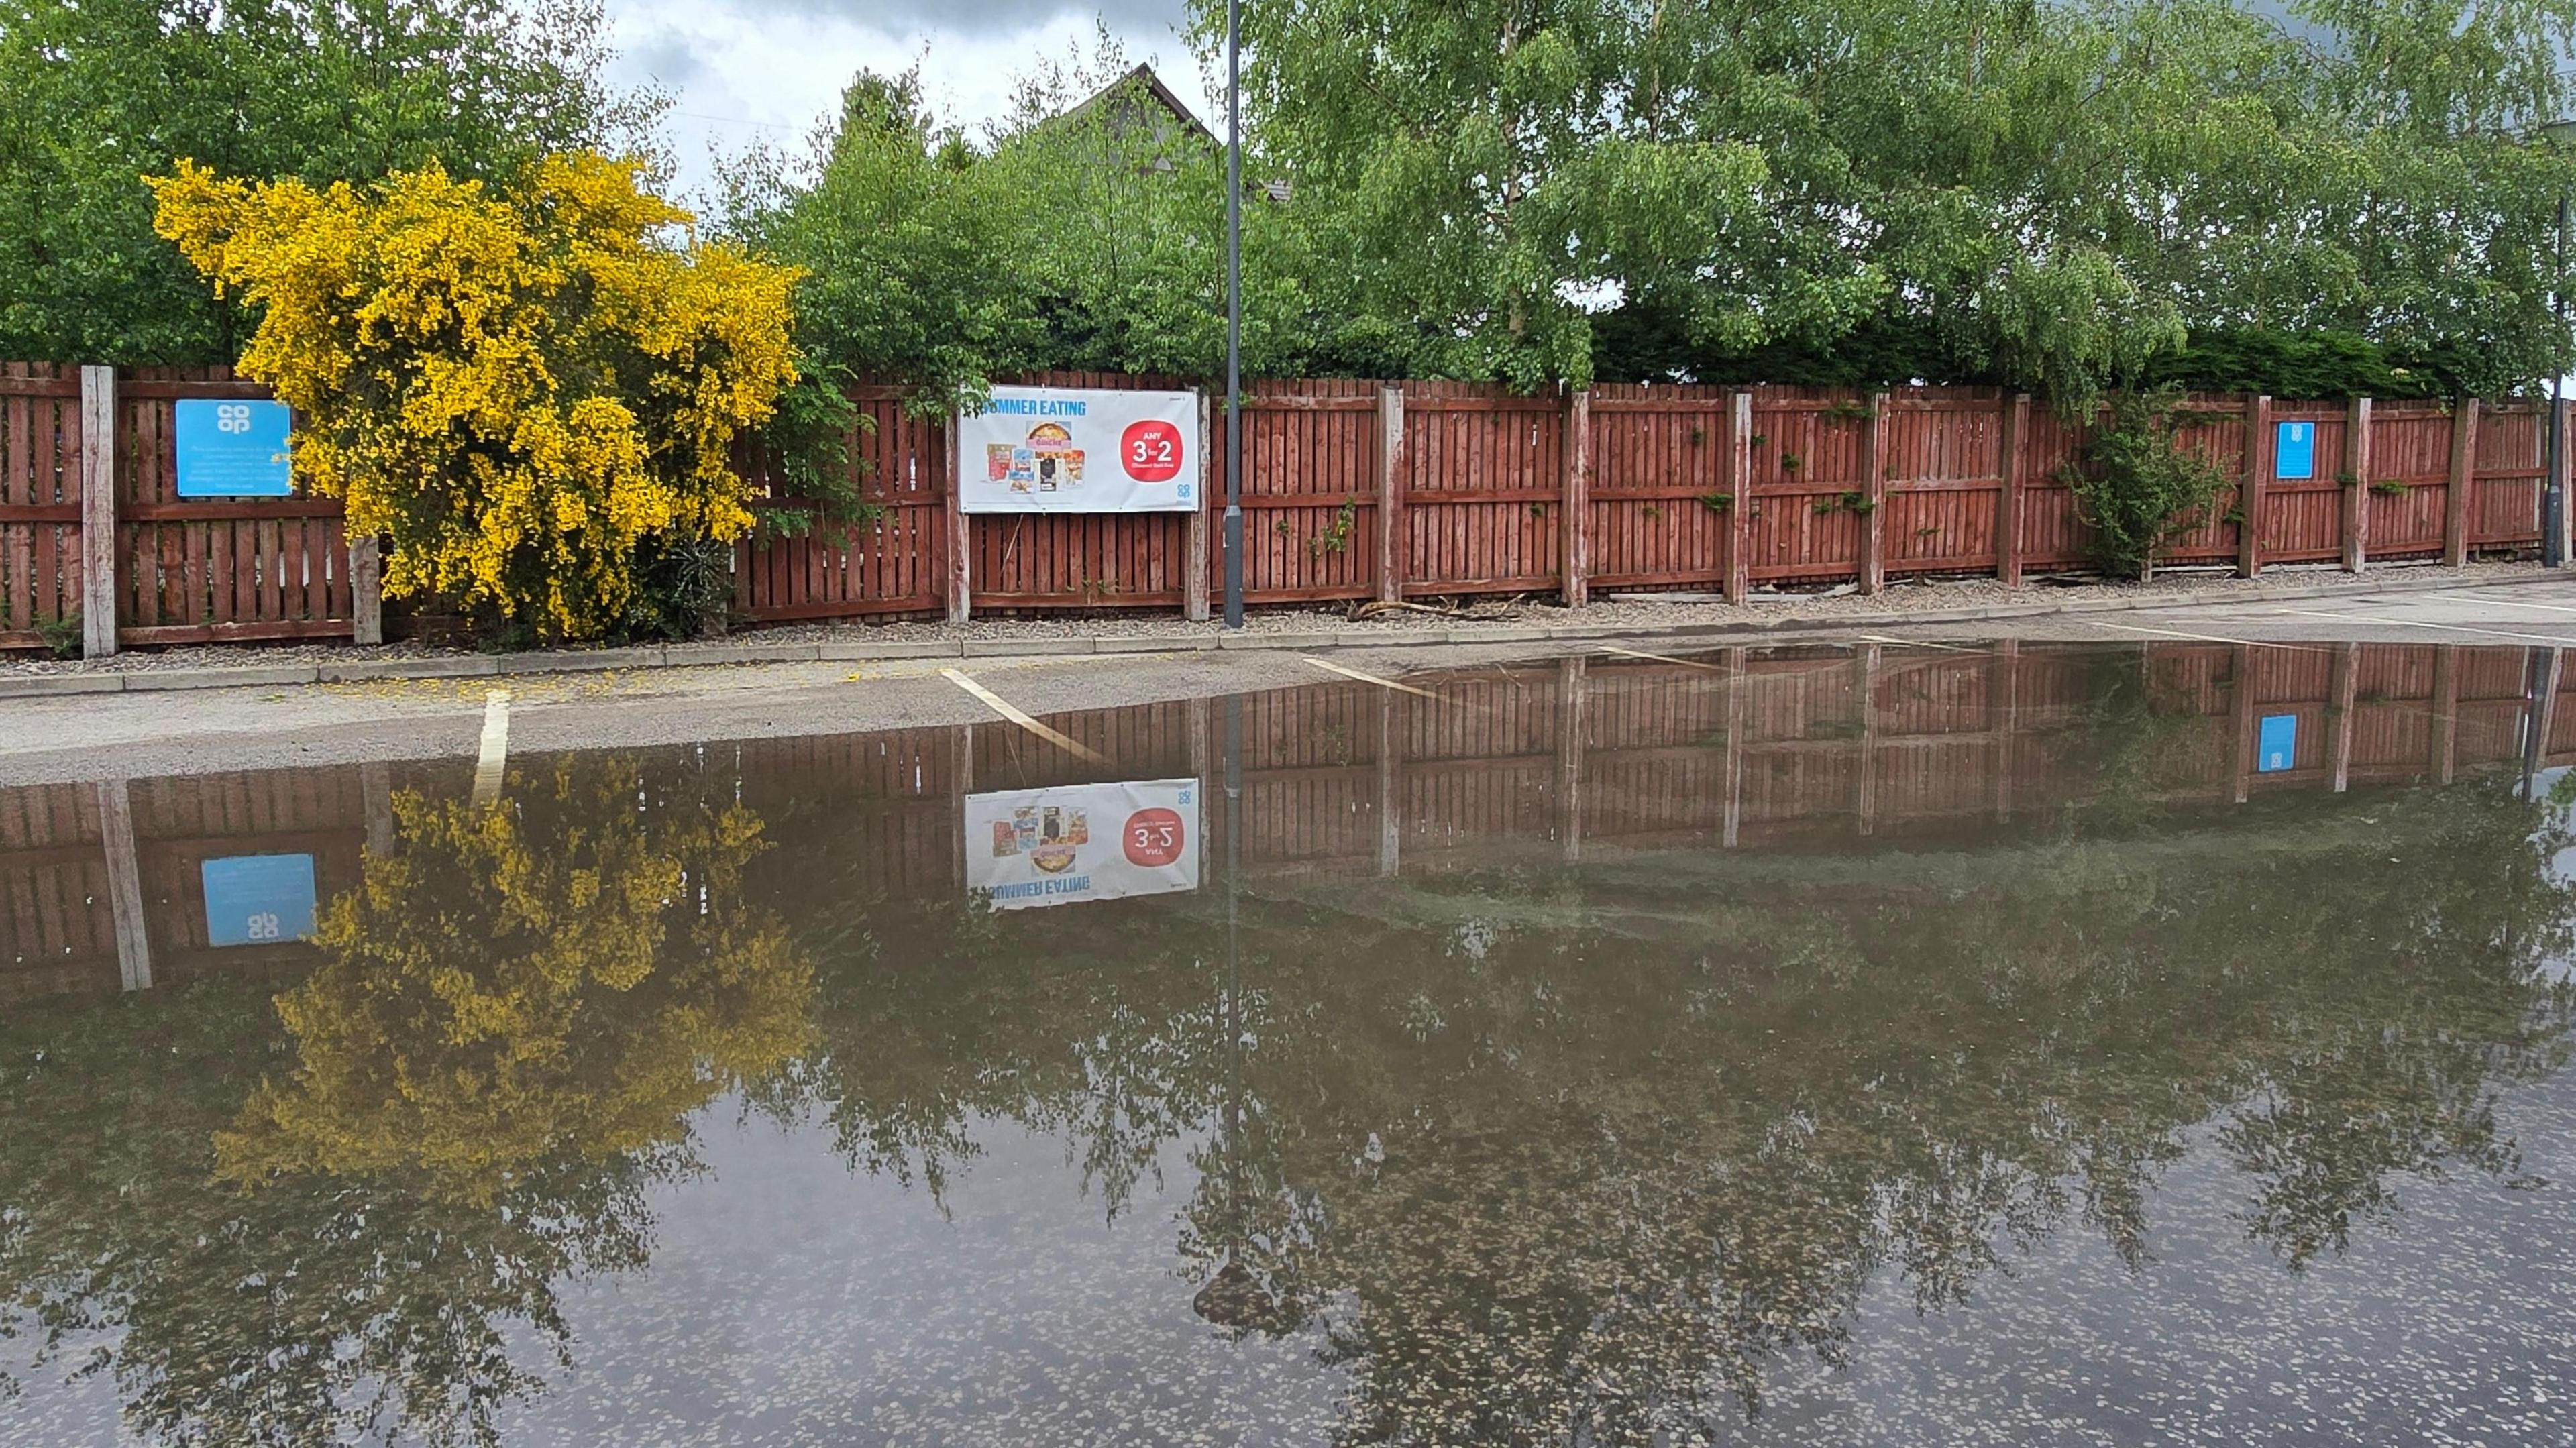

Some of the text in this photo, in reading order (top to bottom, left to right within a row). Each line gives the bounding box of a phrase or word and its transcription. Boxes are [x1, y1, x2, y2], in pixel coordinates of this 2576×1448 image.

[1040, 400, 1086, 416] EATING
[1132, 441, 1147, 461] 3
[1158, 441, 1171, 461] 2
